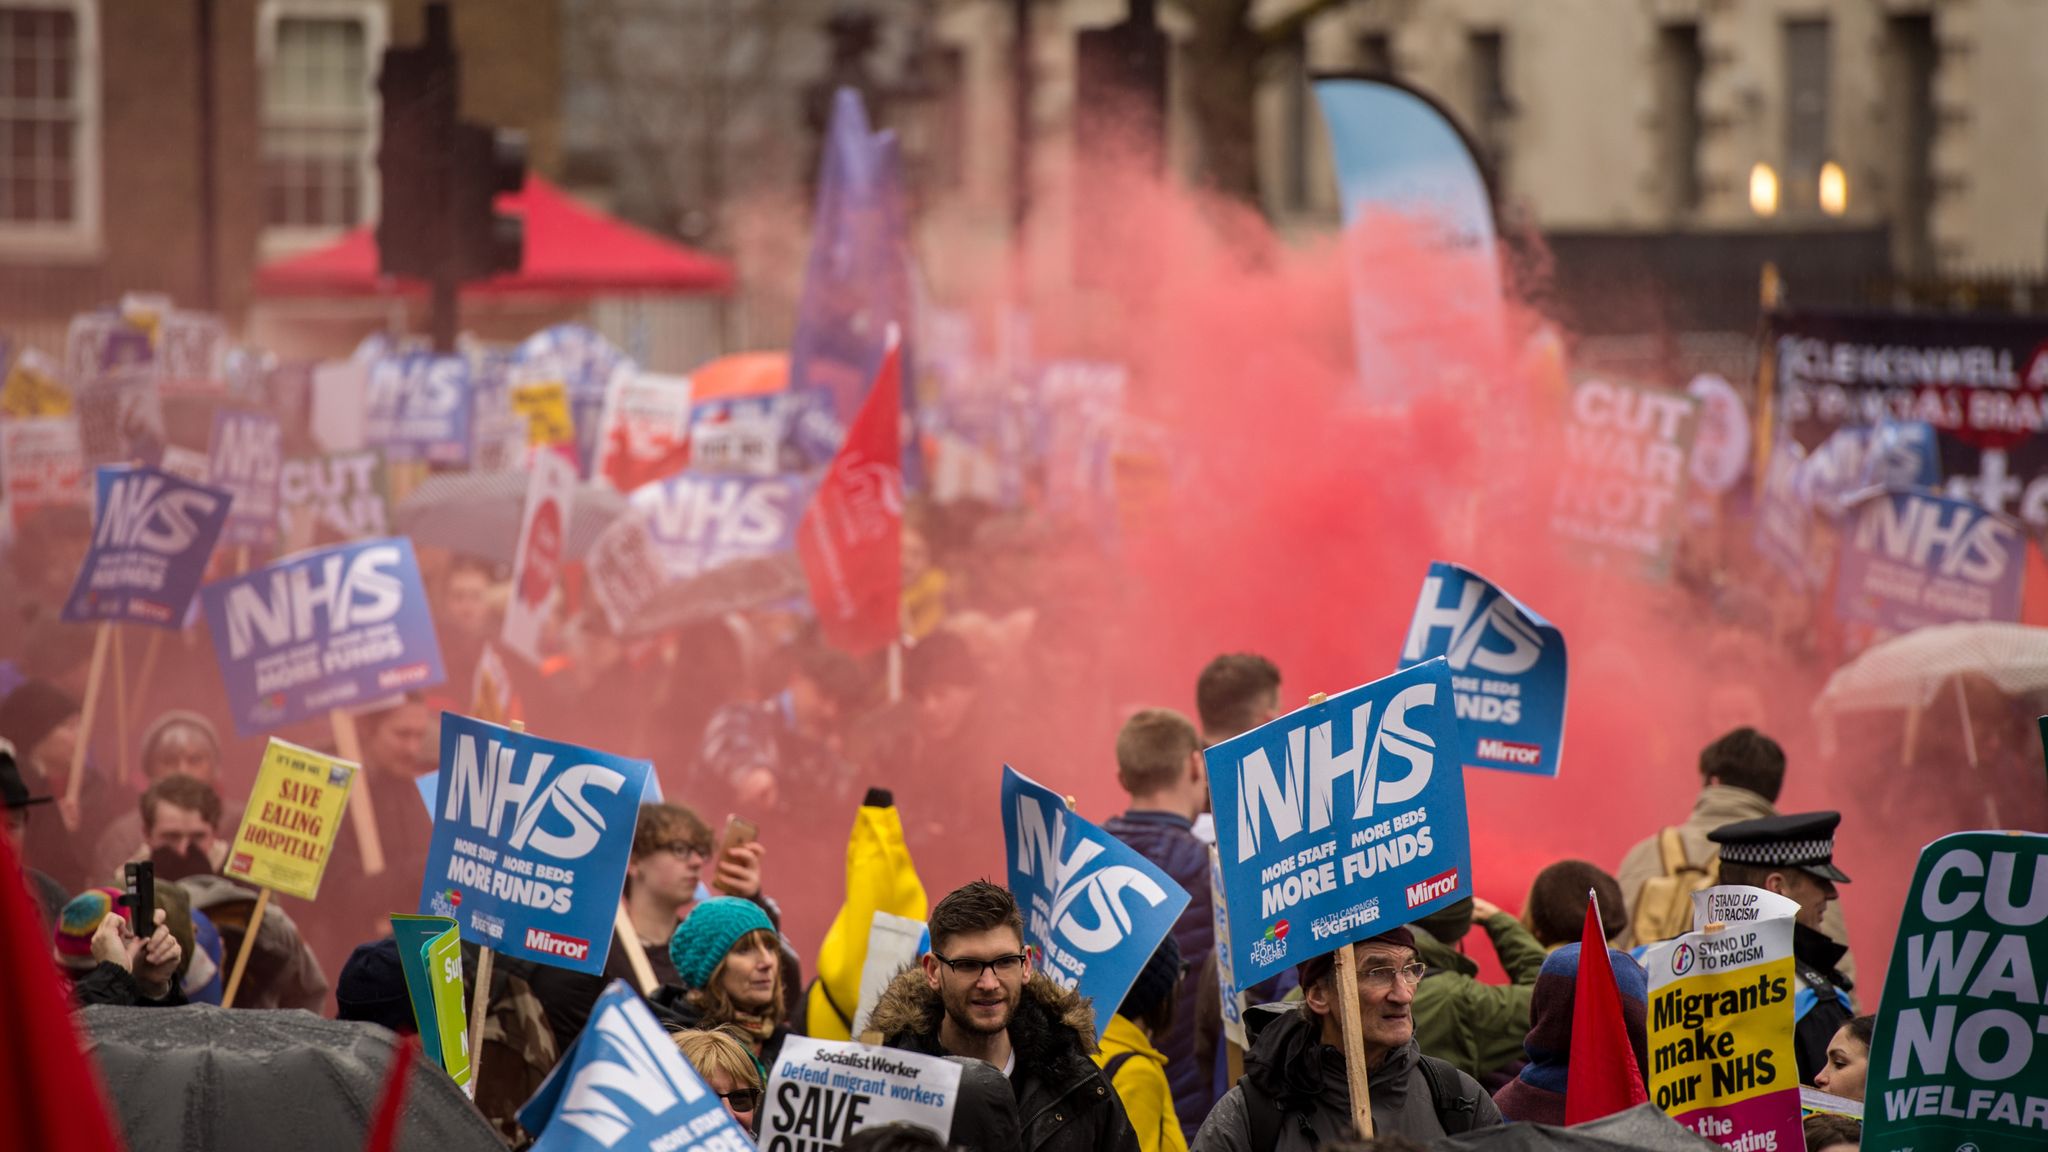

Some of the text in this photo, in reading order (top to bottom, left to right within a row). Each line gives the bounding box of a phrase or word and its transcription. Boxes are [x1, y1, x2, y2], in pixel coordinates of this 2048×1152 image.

[1573, 378, 1694, 440] CUT
[1564, 424, 1684, 484] WAR
[280, 453, 377, 502] CUT
[96, 474, 219, 556] NHS
[1854, 495, 2018, 584] NHS
[224, 546, 404, 661] NHS
[1455, 693, 1521, 726] NDS
[1482, 678, 1521, 697] BEDS
[1237, 682, 1437, 865] NHS
[1477, 739, 1540, 764] Mirror
[278, 777, 323, 810] SAVE
[444, 733, 627, 860] NHS
[260, 800, 323, 838] EALING
[243, 822, 325, 864] HOSPITAL!
[453, 837, 575, 885] MORE STAFF MORE BEDS
[1261, 806, 1428, 885] MORE STAFF MORE BEDS
[447, 854, 574, 915] MORE FUNDS
[1261, 825, 1434, 920] MORE FUNDS
[1406, 872, 1458, 908] Mirror
[1339, 896, 1380, 919] CAMPAIGNS
[1714, 893, 1759, 908] STAND UP
[1714, 907, 1760, 922] TO RACISM
[525, 928, 588, 960] Mirror
[1252, 937, 1267, 952] THE
[1311, 905, 1381, 941] TOGETHER
[1698, 932, 1757, 956] STAND UP
[1055, 948, 1087, 976] BEDS
[1698, 945, 1764, 970] TO RACISM
[1907, 929, 2048, 1006] WA
[1653, 973, 1788, 1033] Migrants
[814, 1048, 922, 1079] Socialist Worker
[1655, 1026, 1735, 1075] make
[780, 1061, 945, 1108] Defend migrant workers
[1656, 1048, 1777, 1112] our NHS
[772, 1081, 871, 1145] SAVE
[1697, 1115, 1733, 1137] the
